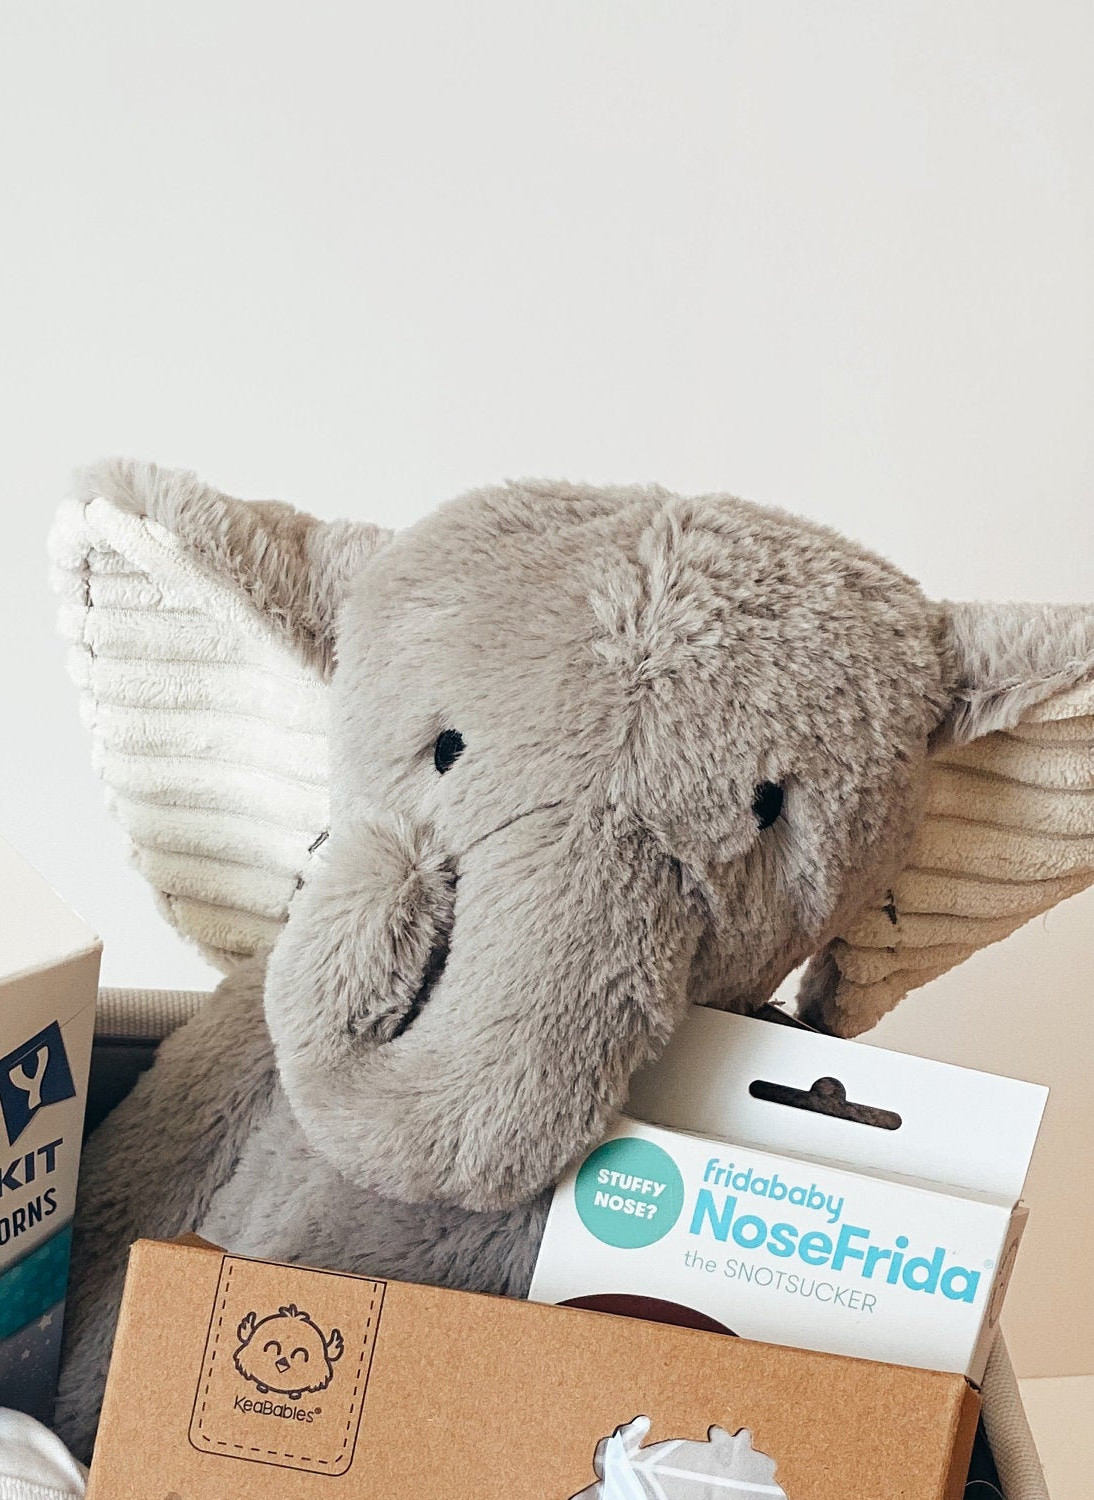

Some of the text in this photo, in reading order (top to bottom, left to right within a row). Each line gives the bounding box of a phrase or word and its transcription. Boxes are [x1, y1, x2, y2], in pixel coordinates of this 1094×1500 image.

[593, 1191, 658, 1220] NOSE?
[597, 1168, 667, 1198] STUFFY
[703, 1158, 844, 1223] fridababy
[684, 1250, 877, 1314] the SNOTSUCKER
